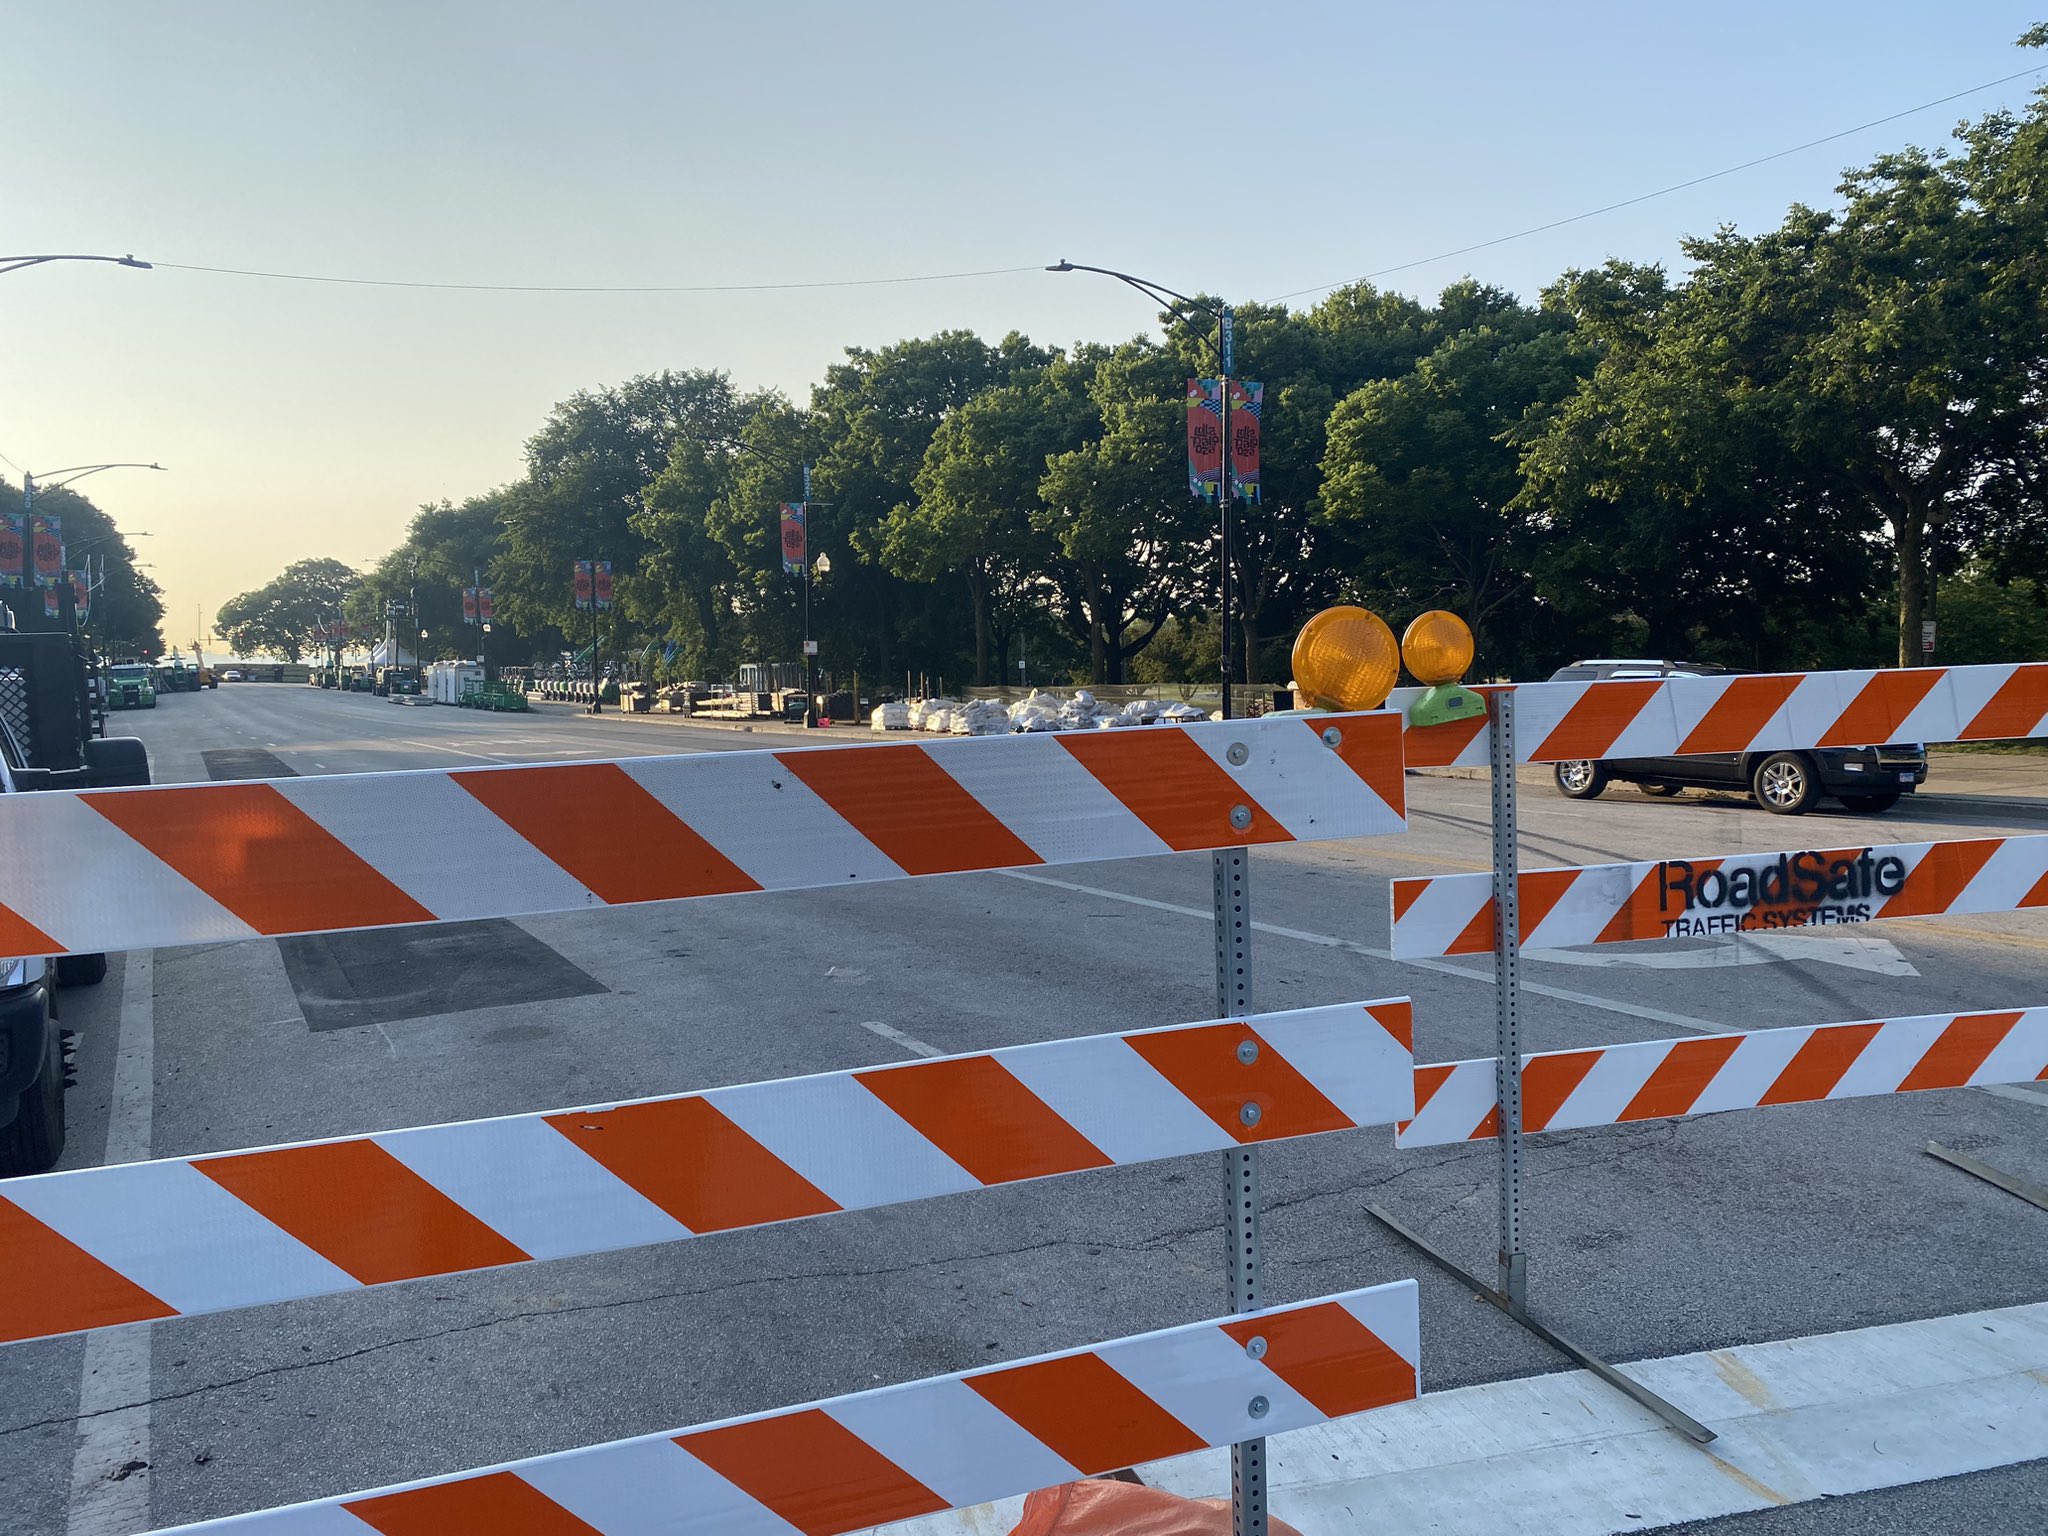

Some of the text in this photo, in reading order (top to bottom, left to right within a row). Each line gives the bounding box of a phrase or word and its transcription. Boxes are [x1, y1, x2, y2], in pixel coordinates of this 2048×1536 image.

[1224, 317, 1233, 367] B311
[1659, 848, 1906, 912] RoadSafe
[1661, 903, 1871, 939] TRAFFIC SYSTEMS
